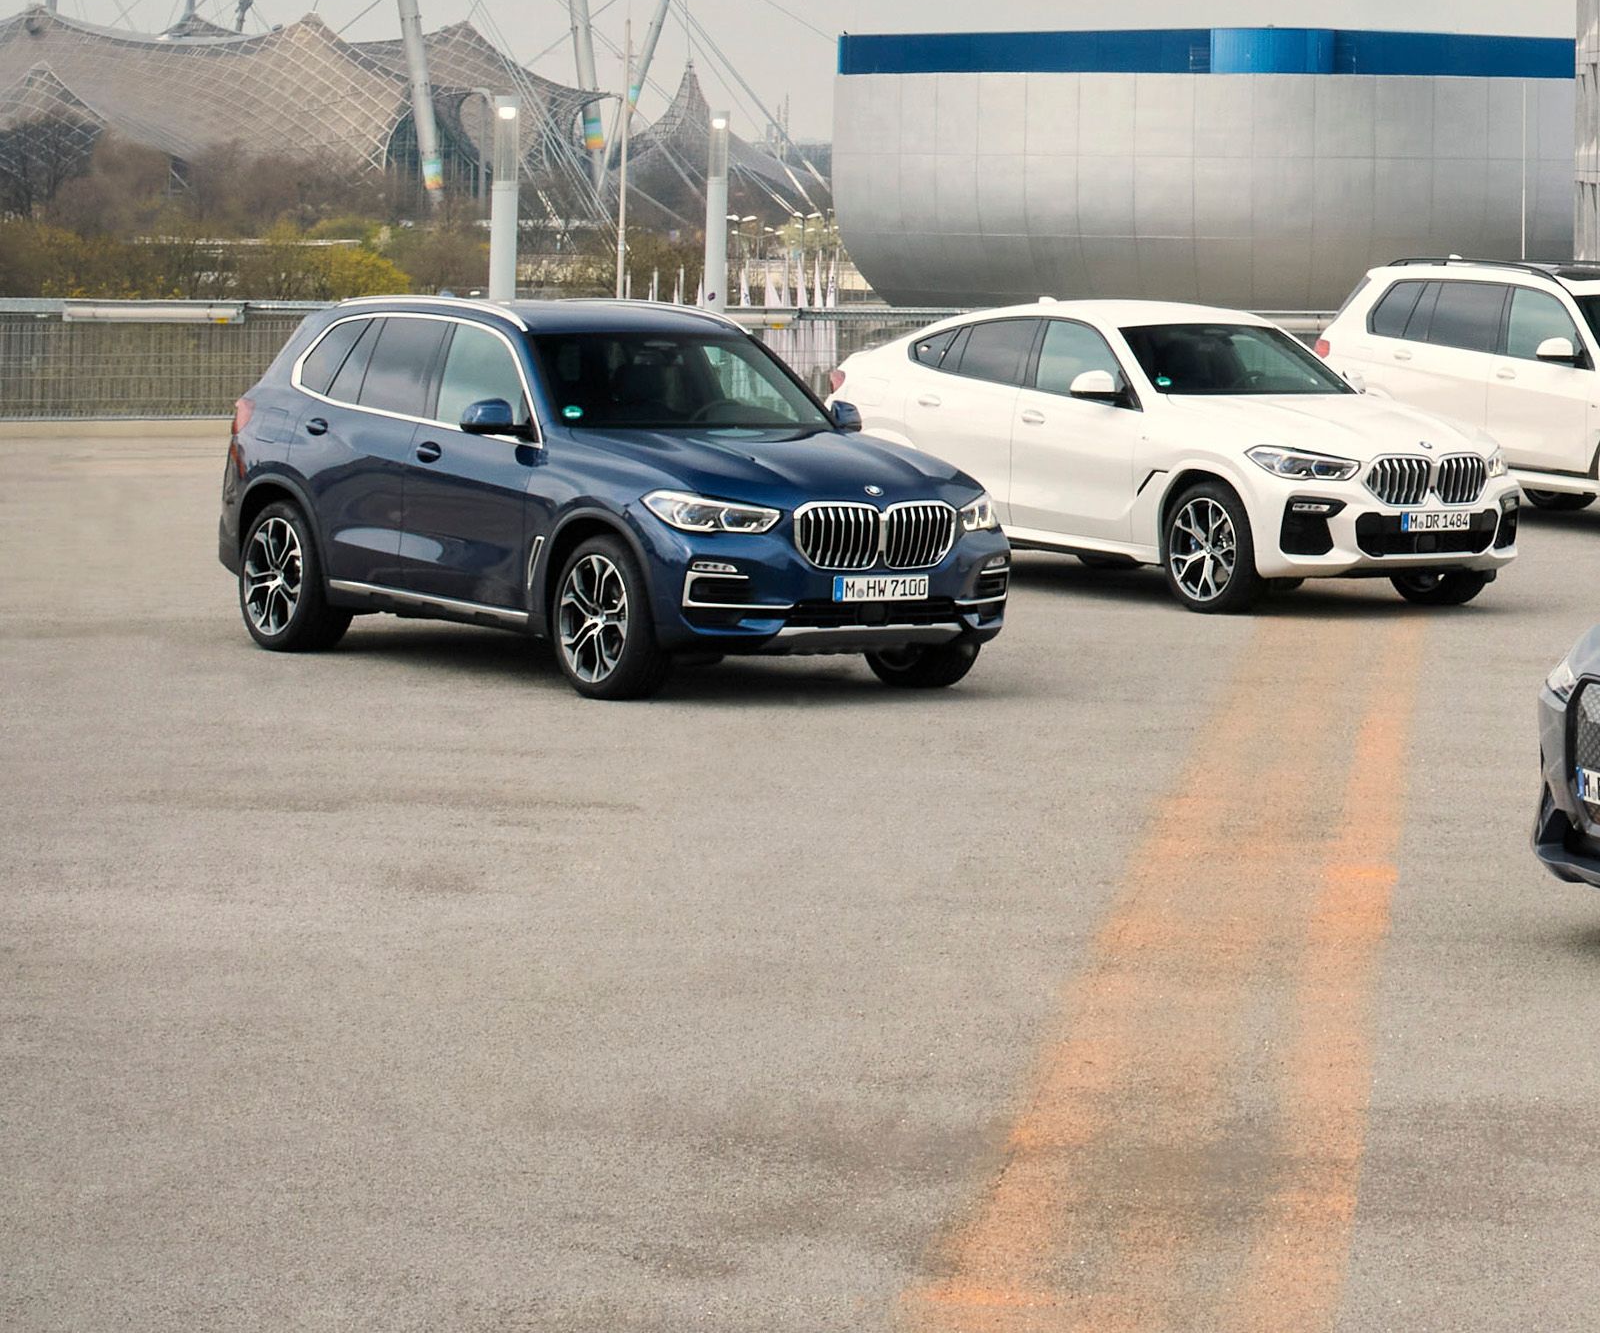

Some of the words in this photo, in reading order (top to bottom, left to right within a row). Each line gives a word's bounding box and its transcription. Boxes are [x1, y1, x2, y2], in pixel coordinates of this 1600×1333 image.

[1410, 514, 1418, 529] M
[1425, 514, 1440, 529] DR
[1442, 513, 1468, 528] 1484
[844, 580, 855, 598] M
[866, 579, 887, 598] HW
[890, 578, 926, 597] 7100
[1583, 773, 1591, 798] M
